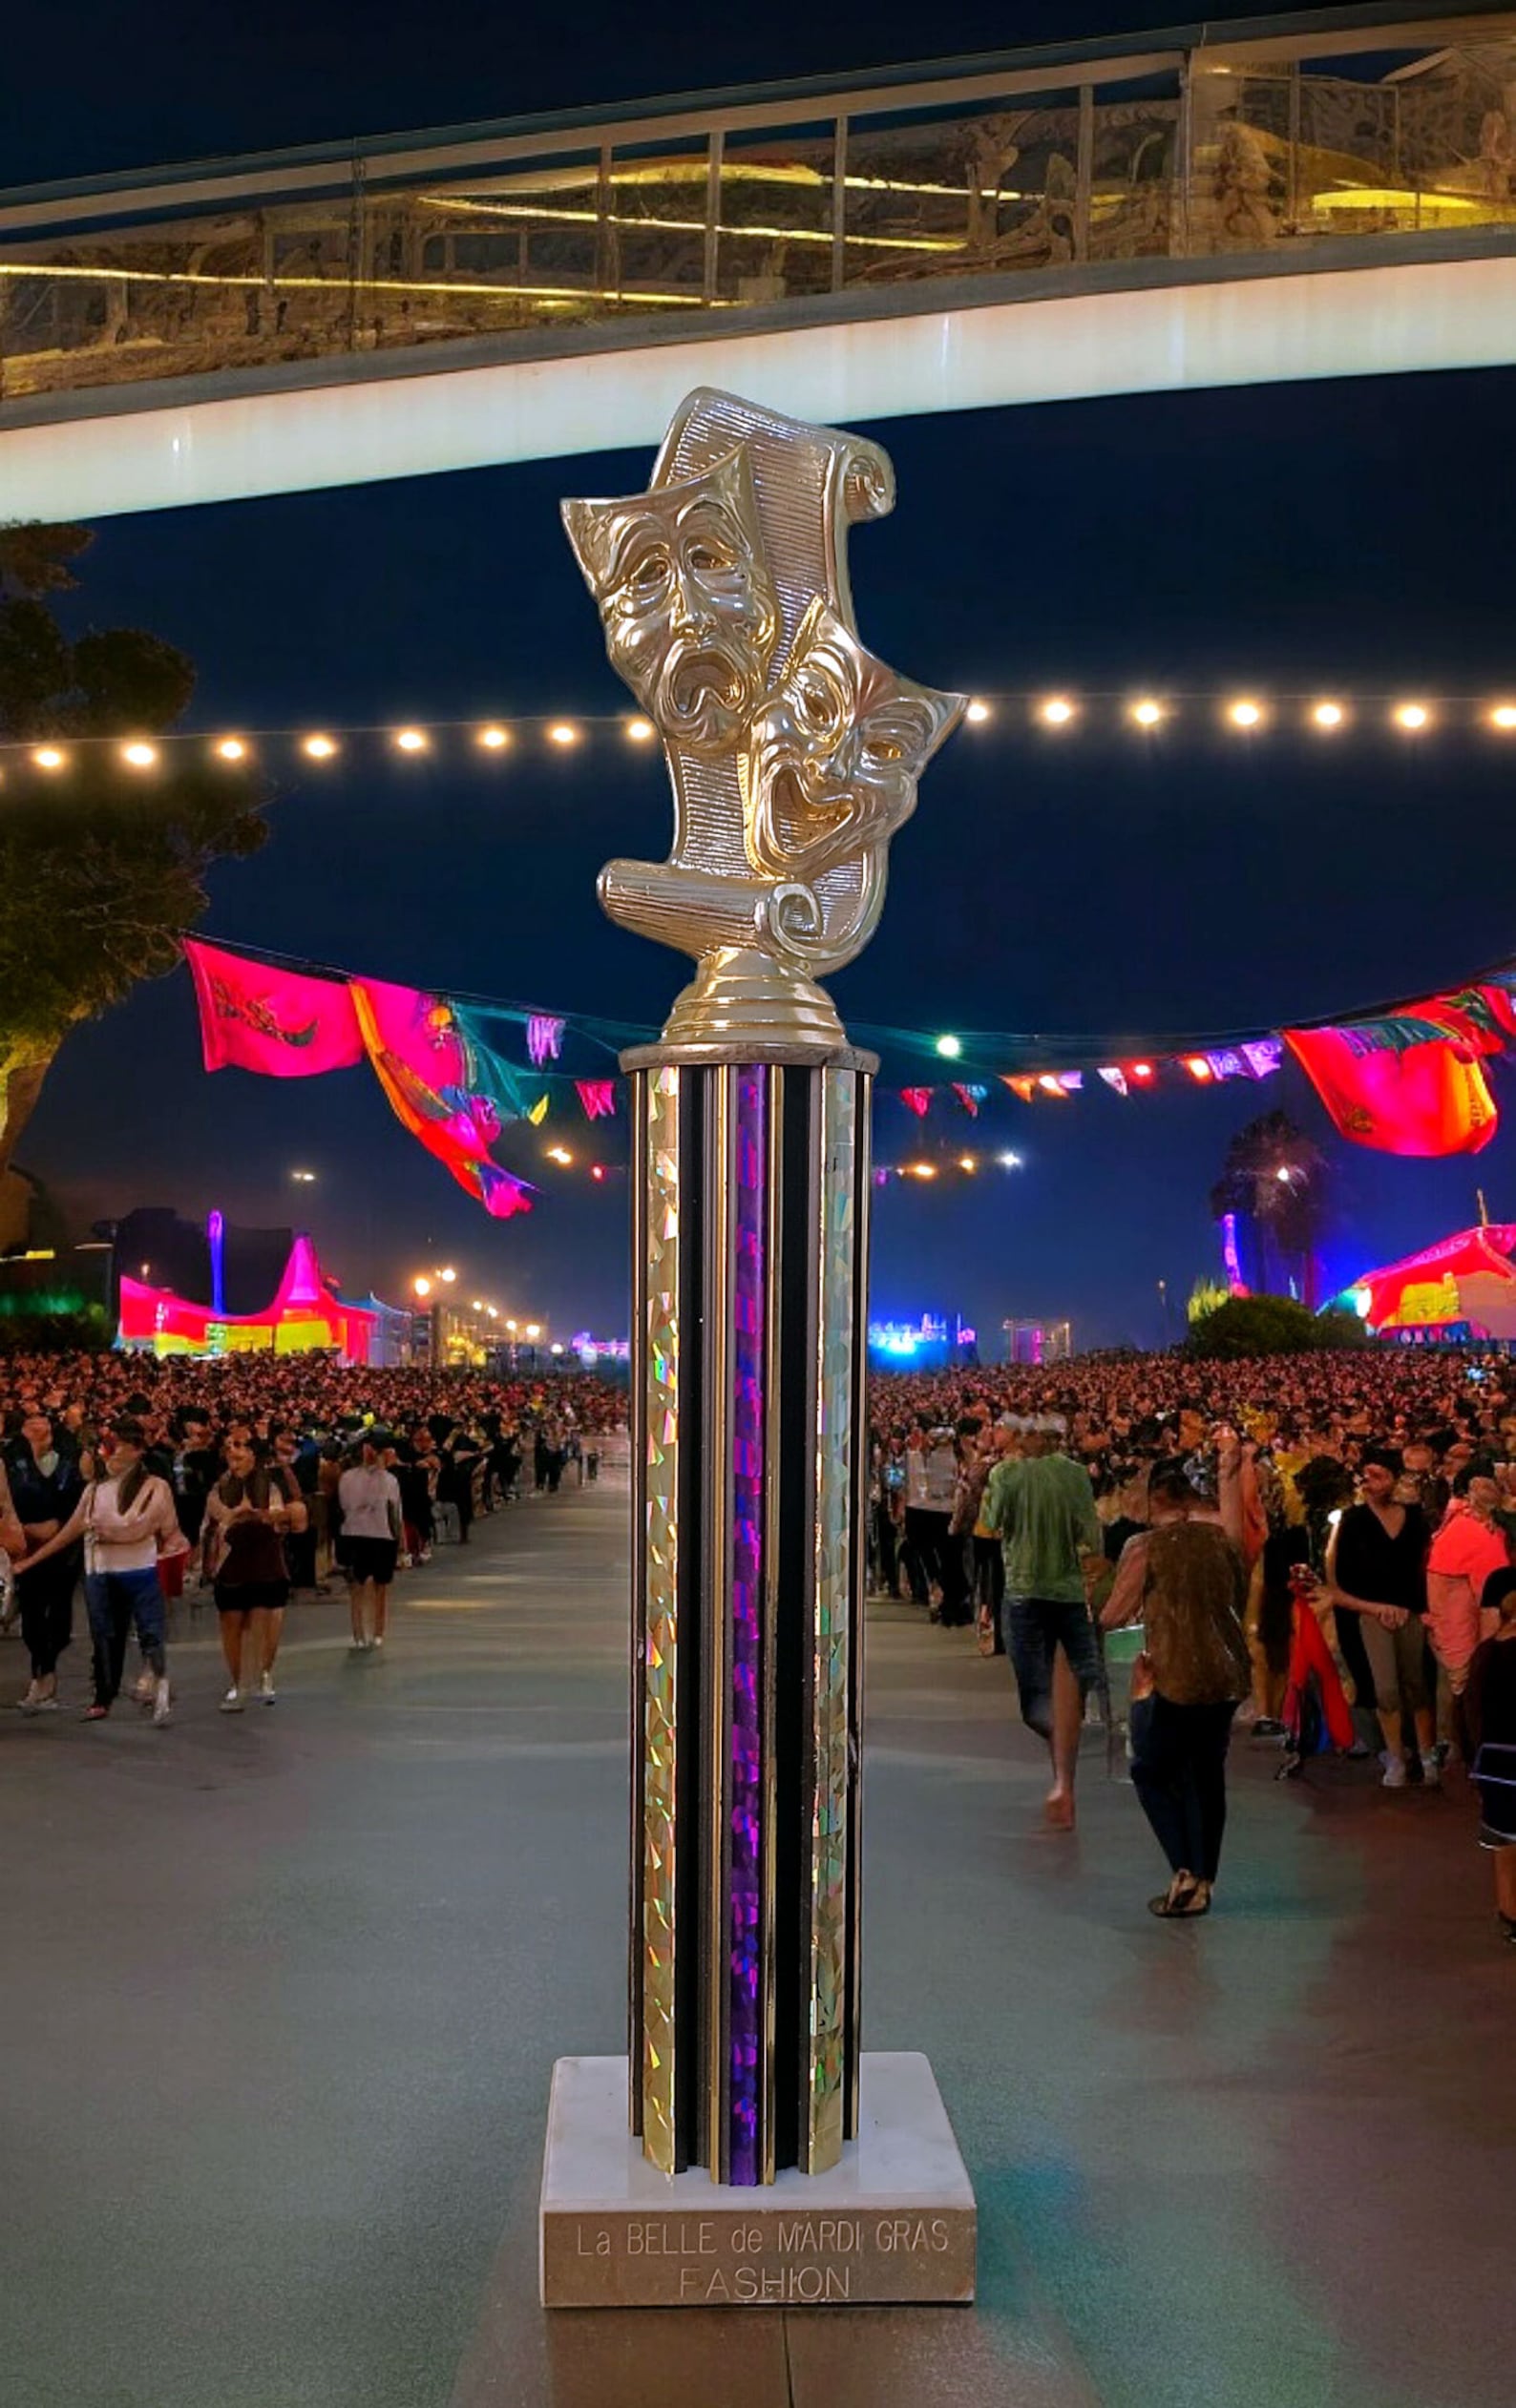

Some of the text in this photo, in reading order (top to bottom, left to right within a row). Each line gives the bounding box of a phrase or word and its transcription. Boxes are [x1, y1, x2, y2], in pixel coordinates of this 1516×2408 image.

[577, 2220, 949, 2255] La BELLE de MARDI GRAS
[680, 2266, 850, 2299] FASHION
